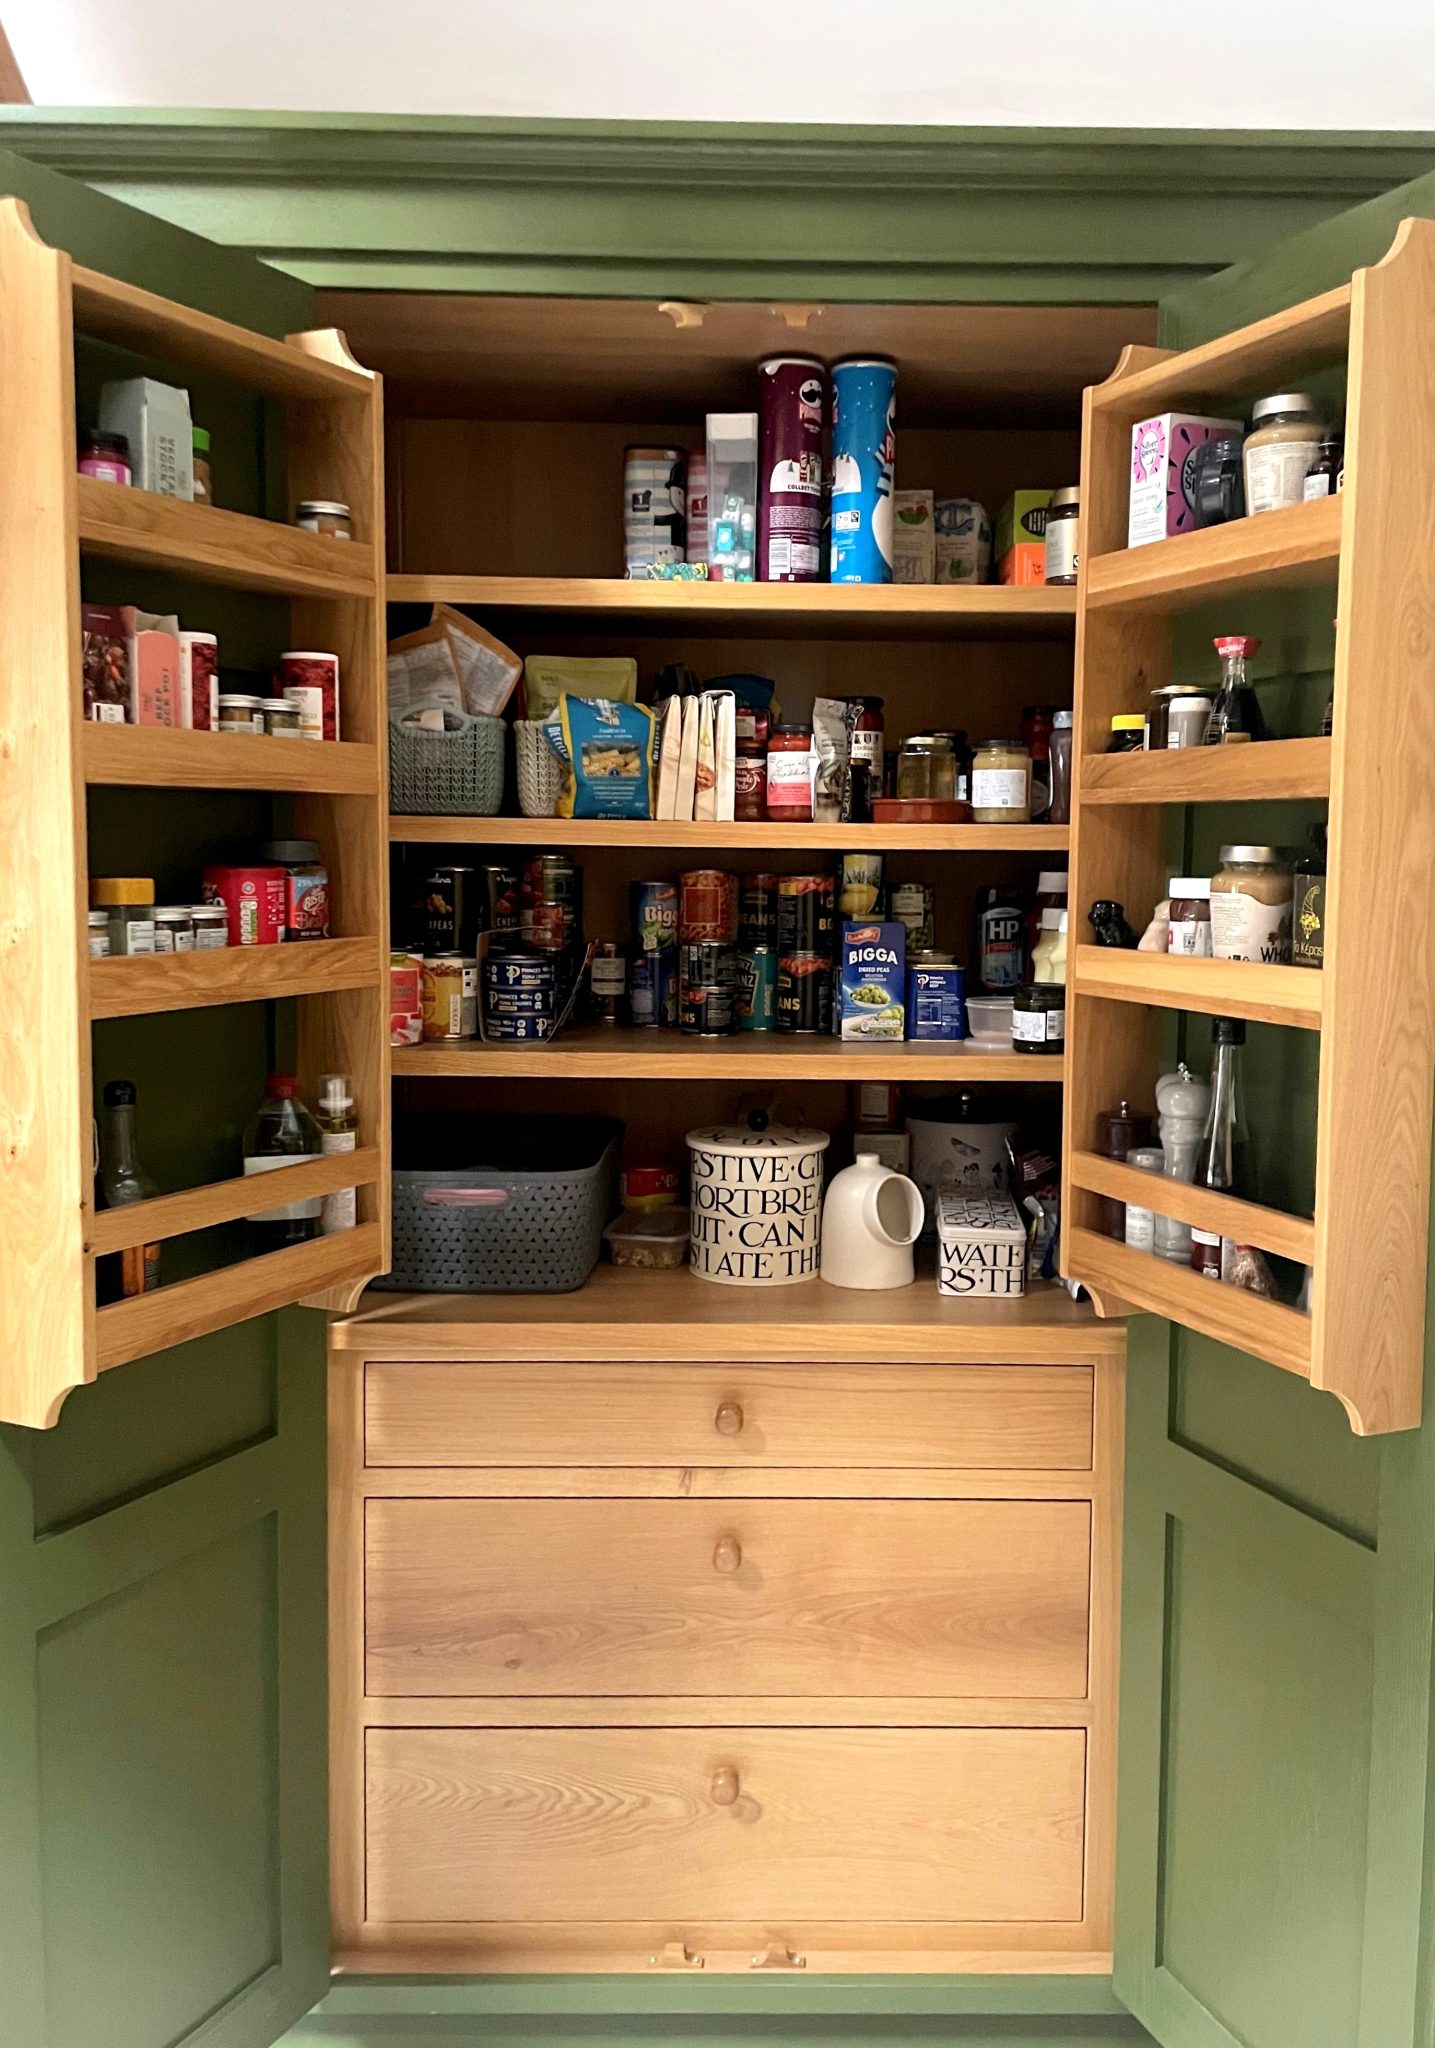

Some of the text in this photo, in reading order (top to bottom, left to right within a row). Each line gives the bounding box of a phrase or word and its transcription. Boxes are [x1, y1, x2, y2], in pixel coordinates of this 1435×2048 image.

[989, 920, 1019, 940] HP
[849, 948, 898, 965] BIGGA
[738, 1218, 806, 1248] CAN
[714, 1251, 774, 1279] ATE
[942, 1242, 1024, 1268] WATE
